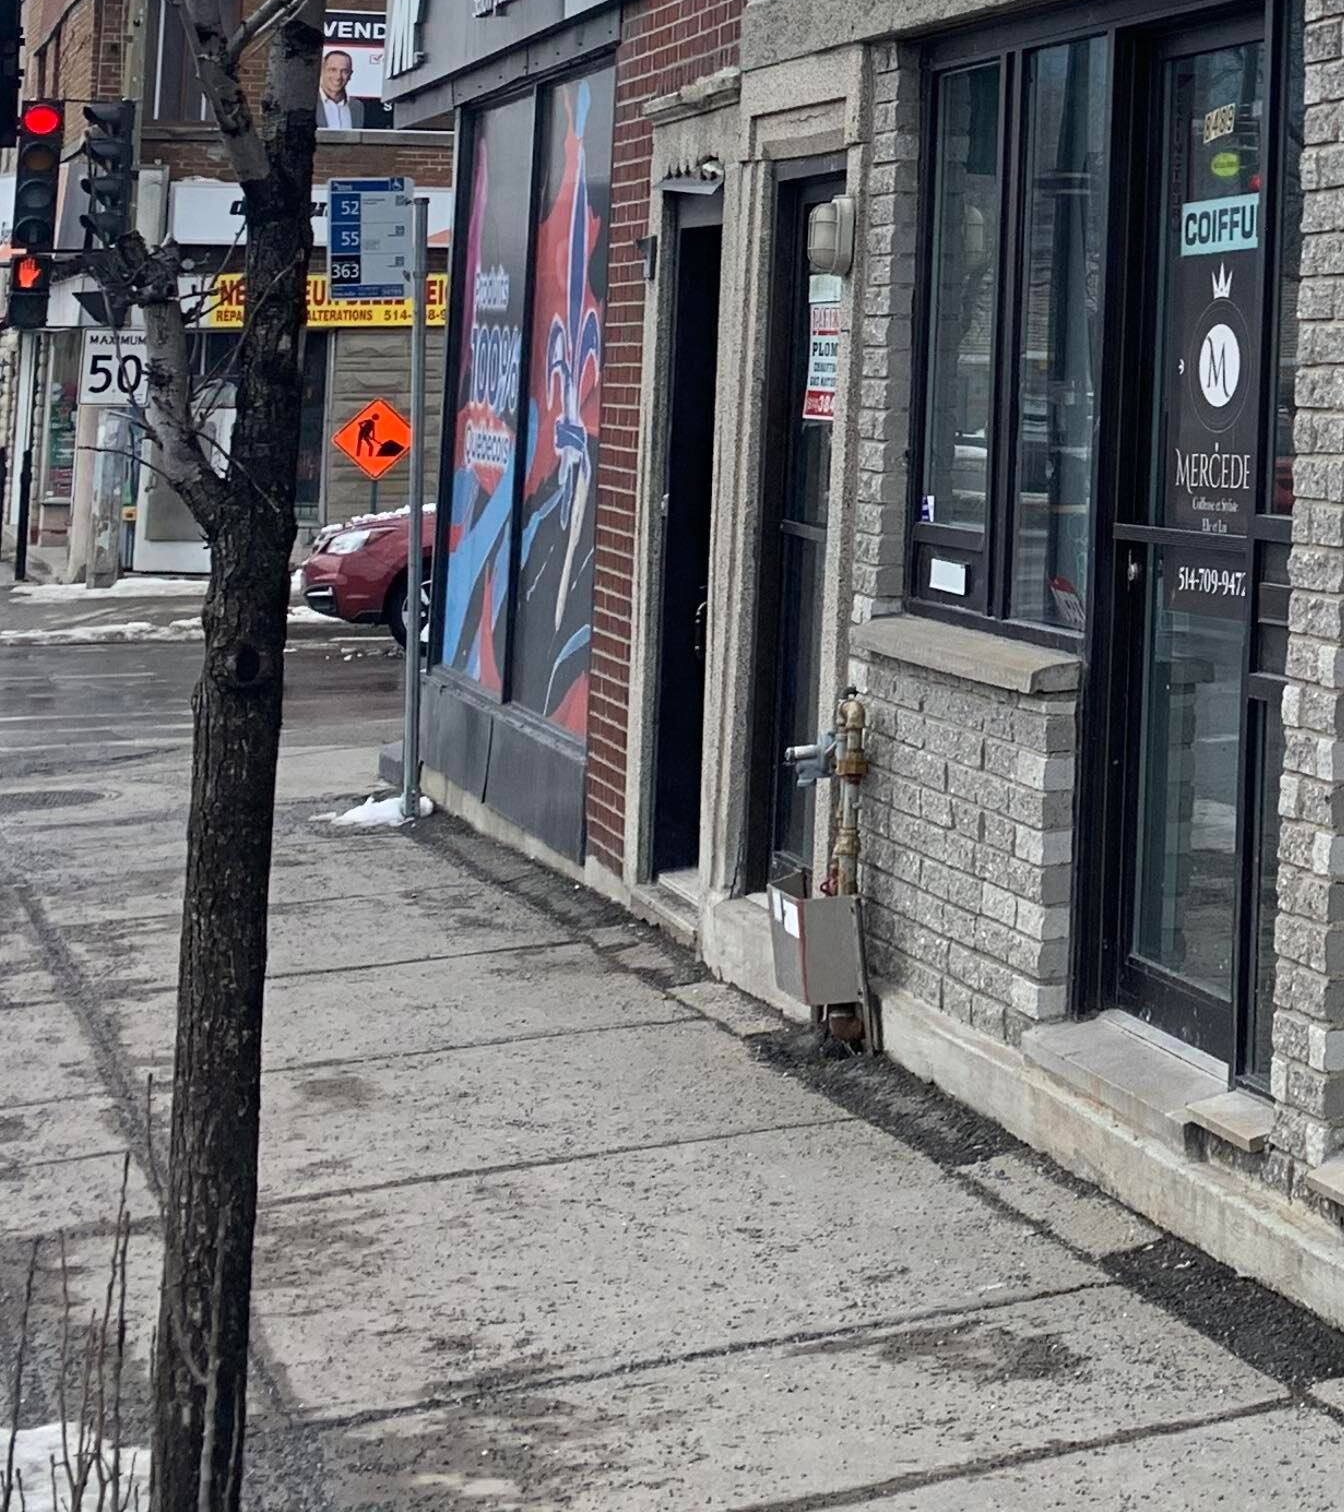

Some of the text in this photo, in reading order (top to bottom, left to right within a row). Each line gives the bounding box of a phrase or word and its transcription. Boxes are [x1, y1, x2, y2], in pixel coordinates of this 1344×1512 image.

[341, 201, 359, 215] 52
[341, 231, 359, 246] 55
[1185, 205, 1258, 246] COIFFU
[331, 263, 359, 279] 363
[90, 335, 146, 346] MAXIMUM
[88, 354, 142, 393] 50
[472, 326, 521, 414] 100%
[1206, 336, 1230, 398] M
